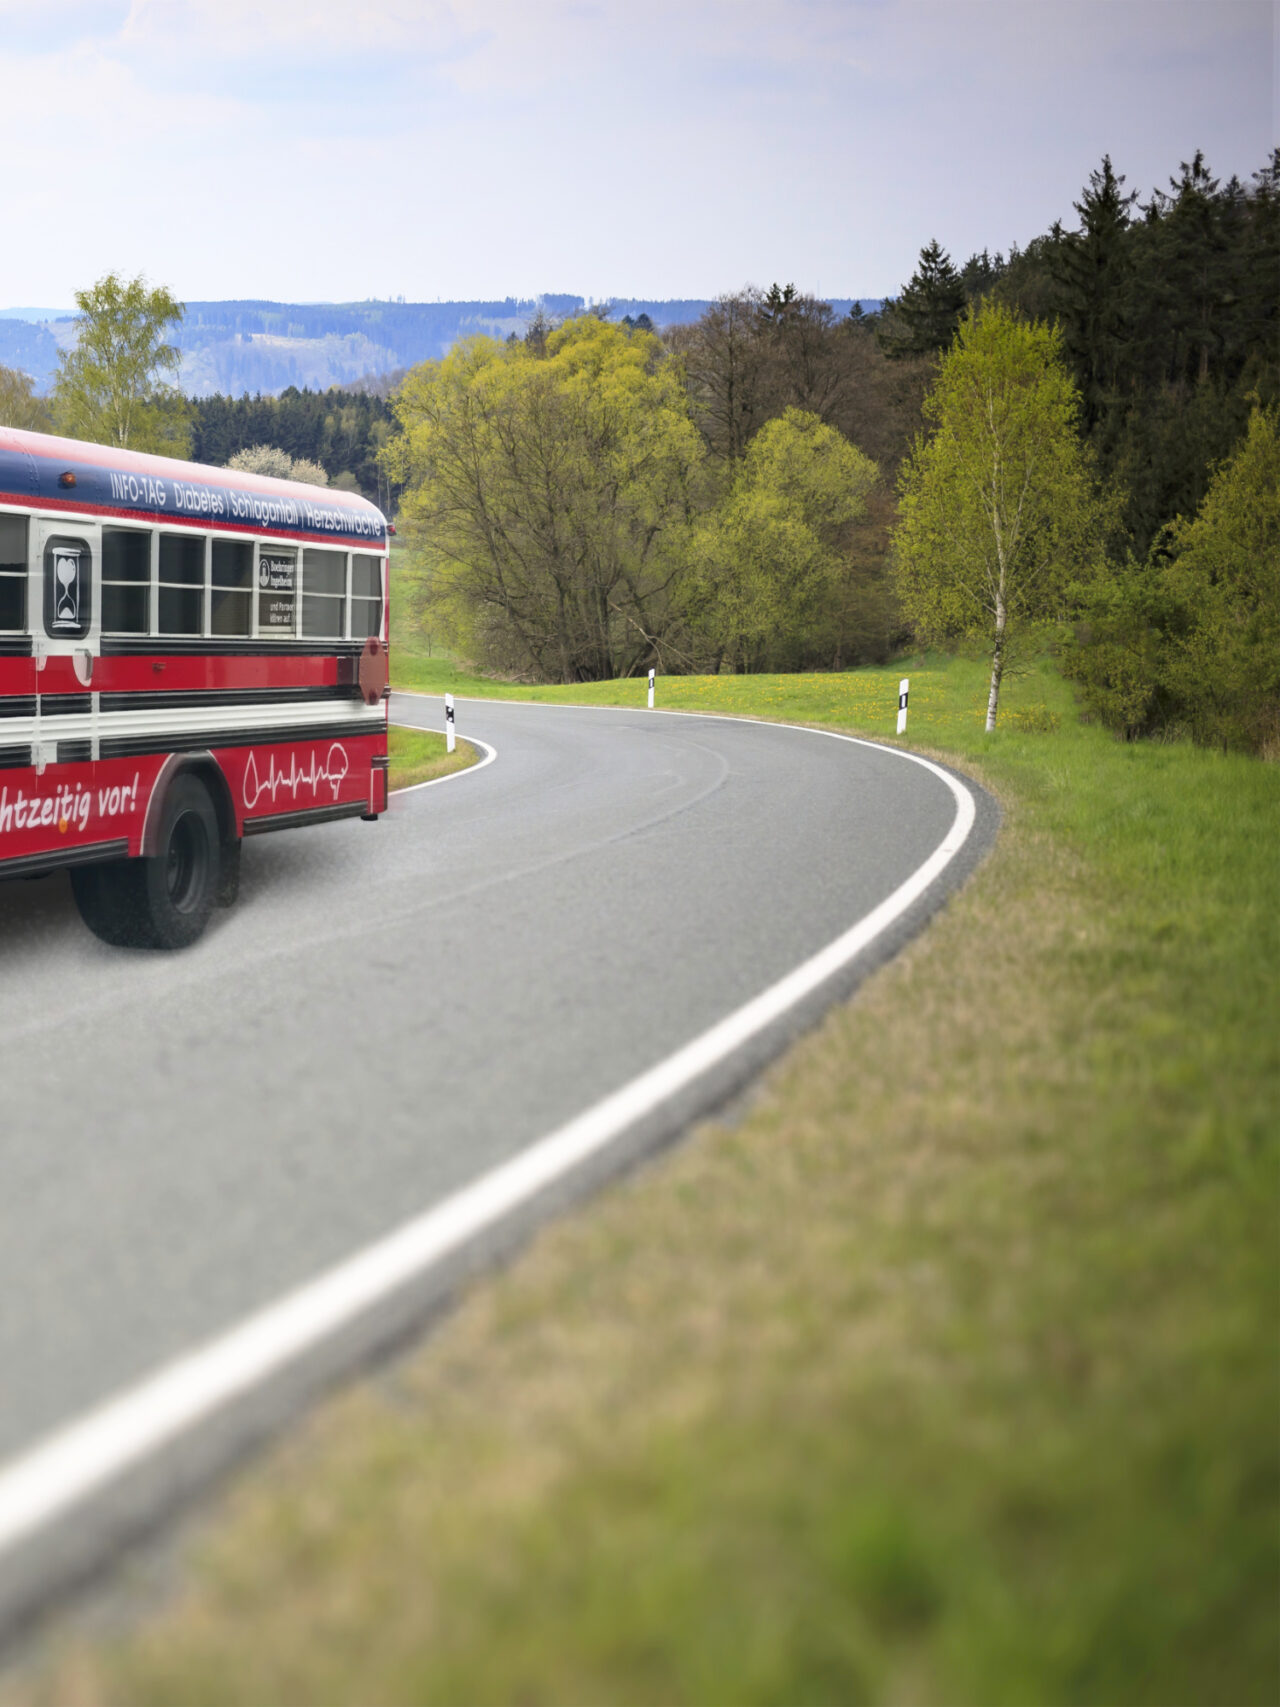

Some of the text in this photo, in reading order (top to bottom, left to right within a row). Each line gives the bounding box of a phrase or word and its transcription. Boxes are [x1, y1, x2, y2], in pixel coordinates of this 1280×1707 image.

[110, 472, 167, 506] INFO-TAG
[173, 482, 224, 514] Diabetes
[230, 491, 299, 527] Schlaganfall
[304, 502, 381, 536] Herzschwäche
[98, 771, 140, 817] vor!
